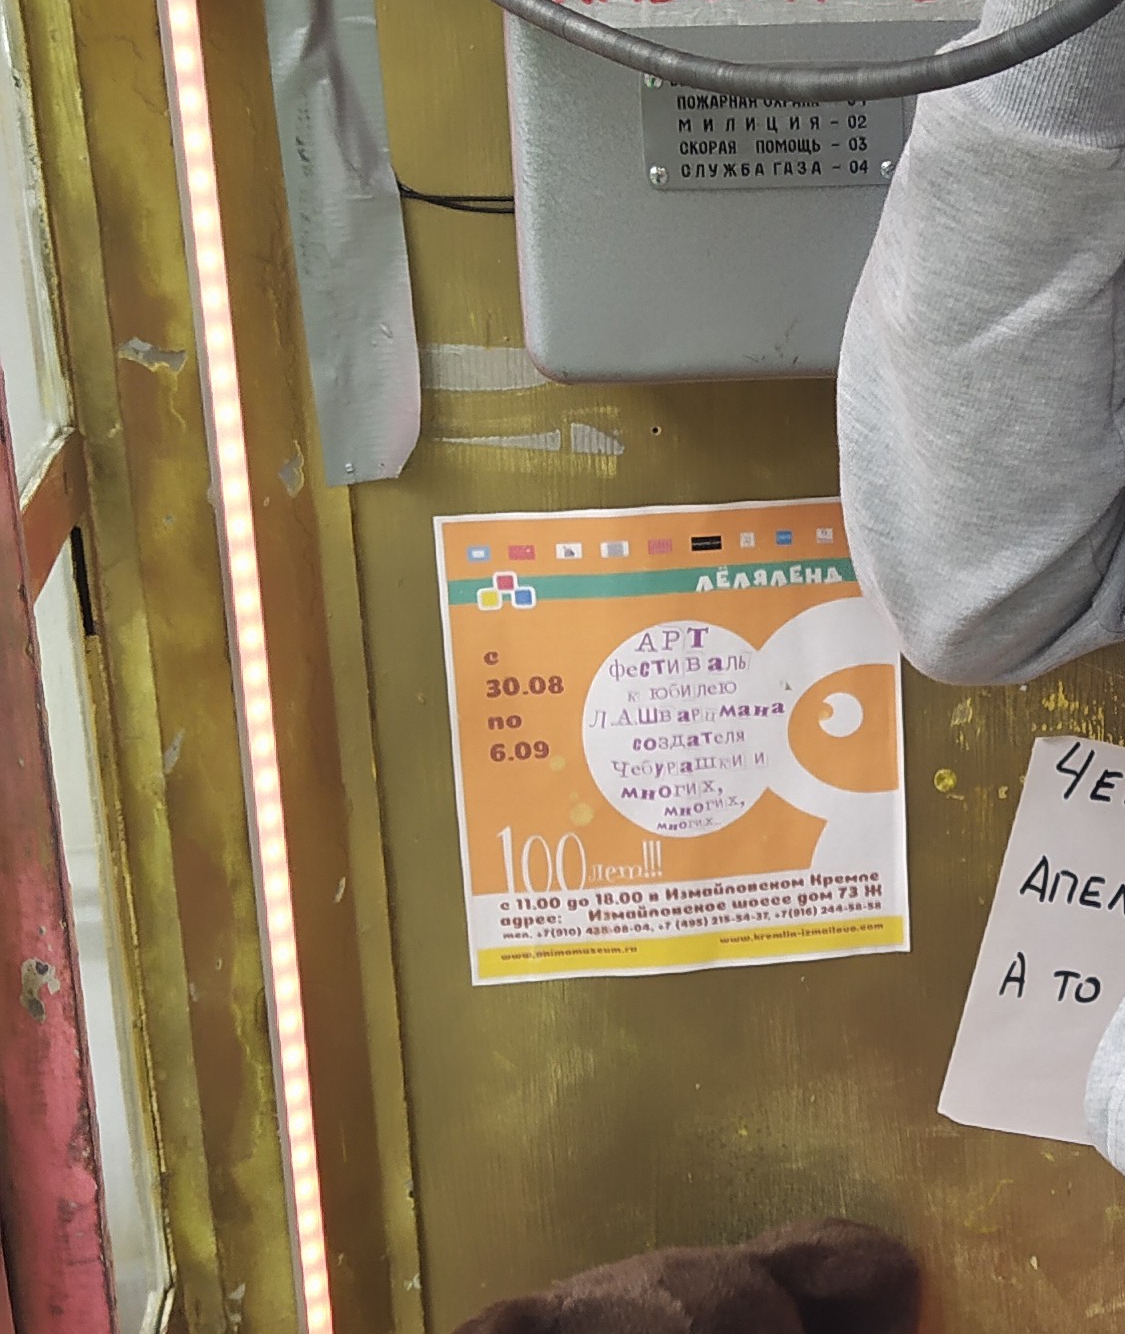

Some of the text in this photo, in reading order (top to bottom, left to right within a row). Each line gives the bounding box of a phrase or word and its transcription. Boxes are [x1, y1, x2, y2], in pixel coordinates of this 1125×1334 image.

[677, 94, 758, 110] ПОЖАРНАЯ
[847, 115, 867, 129] 02
[680, 140, 737, 155] СКОРАЯ
[756, 139, 821, 155] ПОМОЩЬ
[848, 137, 868, 151] 03
[681, 163, 765, 178] СЛУЖБА
[773, 162, 821, 176] ГАЗА
[849, 161, 869, 175] 04
[635, 627, 709, 652] АРТ
[486, 675, 564, 698] 30.08
[487, 715, 522, 730] по
[490, 740, 550, 762] 6.09
[632, 730, 746, 752] создателя
[611, 752, 766, 778] Чебурашки и
[621, 780, 724, 800] многих,
[664, 795, 745, 816] многих,
[496, 826, 663, 894] 100 лет!!!
[516, 897, 561, 911] 11.00
[567, 898, 590, 912] до
[595, 891, 643, 906] 18.00
[665, 877, 804, 901] Измайловском
[810, 871, 880, 888] Кремле
[500, 884, 882, 930] адрес: Измайловское шоссе дом 73 Ж
[999, 952, 1102, 1003] А ТО
